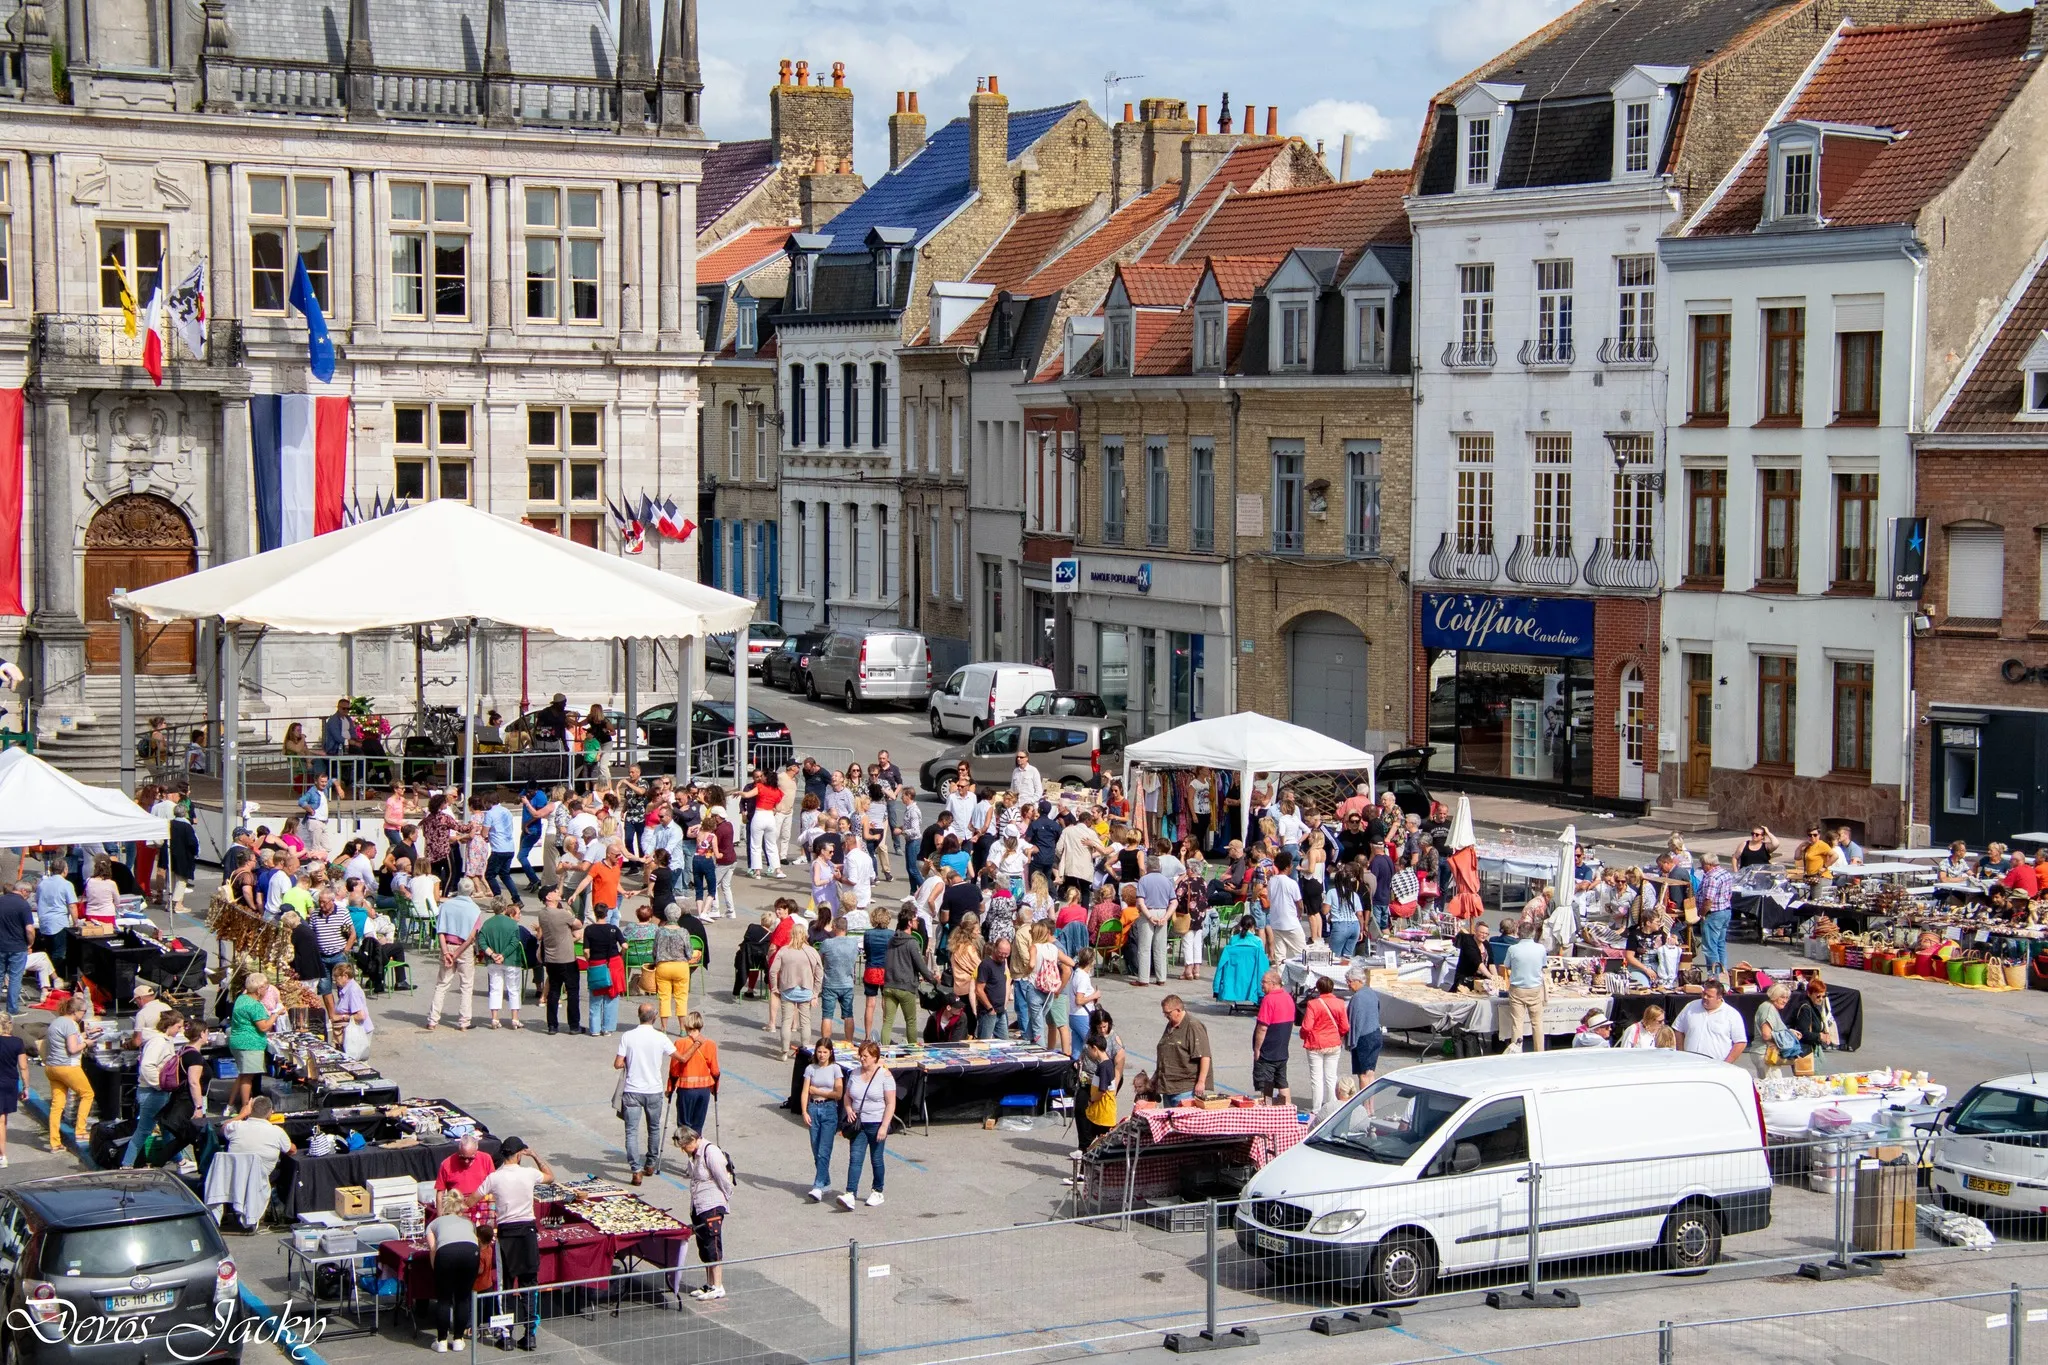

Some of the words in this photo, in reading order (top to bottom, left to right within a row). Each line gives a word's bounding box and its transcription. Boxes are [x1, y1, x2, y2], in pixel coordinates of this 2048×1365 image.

[1091, 572, 1110, 582] BANQUE
[1111, 574, 1138, 585] POPULAIRE
[1896, 574, 1919, 582] Crédit
[1896, 590, 1913, 598] Nord
[1435, 597, 1536, 647] Coiffure
[1532, 629, 1580, 645] Caroline
[1465, 661, 1482, 671] AVEC
[1483, 662, 1491, 672] ET
[1491, 664, 1510, 673] SANS
[1510, 664, 1558, 676] RENDEZ-VOUS
